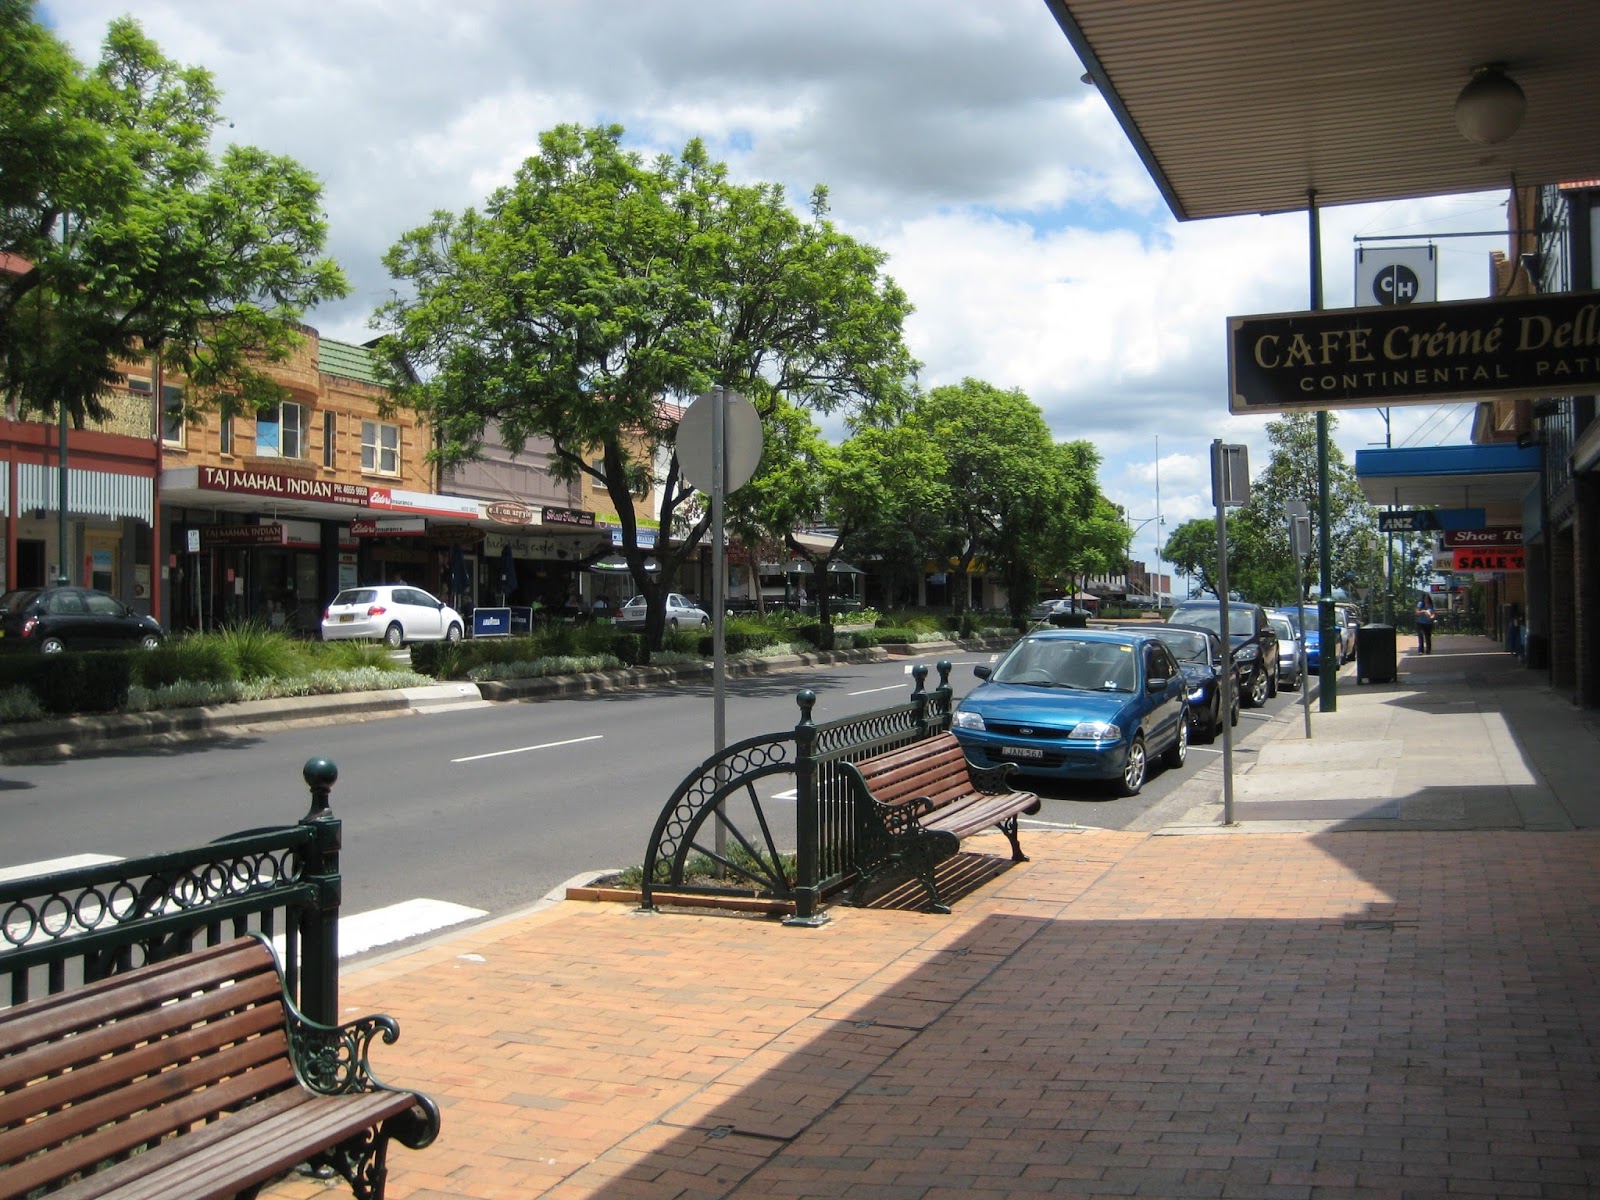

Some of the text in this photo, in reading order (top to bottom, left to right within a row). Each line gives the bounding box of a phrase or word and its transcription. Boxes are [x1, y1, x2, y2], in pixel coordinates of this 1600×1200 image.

[1254, 328, 1375, 369] CAFE
[1516, 303, 1600, 351] Dell
[1300, 365, 1510, 392] CONTINENTAL
[205, 467, 332, 498] TAJ MAHAL INDIAN
[1382, 518, 1413, 529] ANZ
[251, 526, 281, 536] INDIAN
[1454, 531, 1497, 541] Shoe
[1458, 556, 1507, 569] SALE
